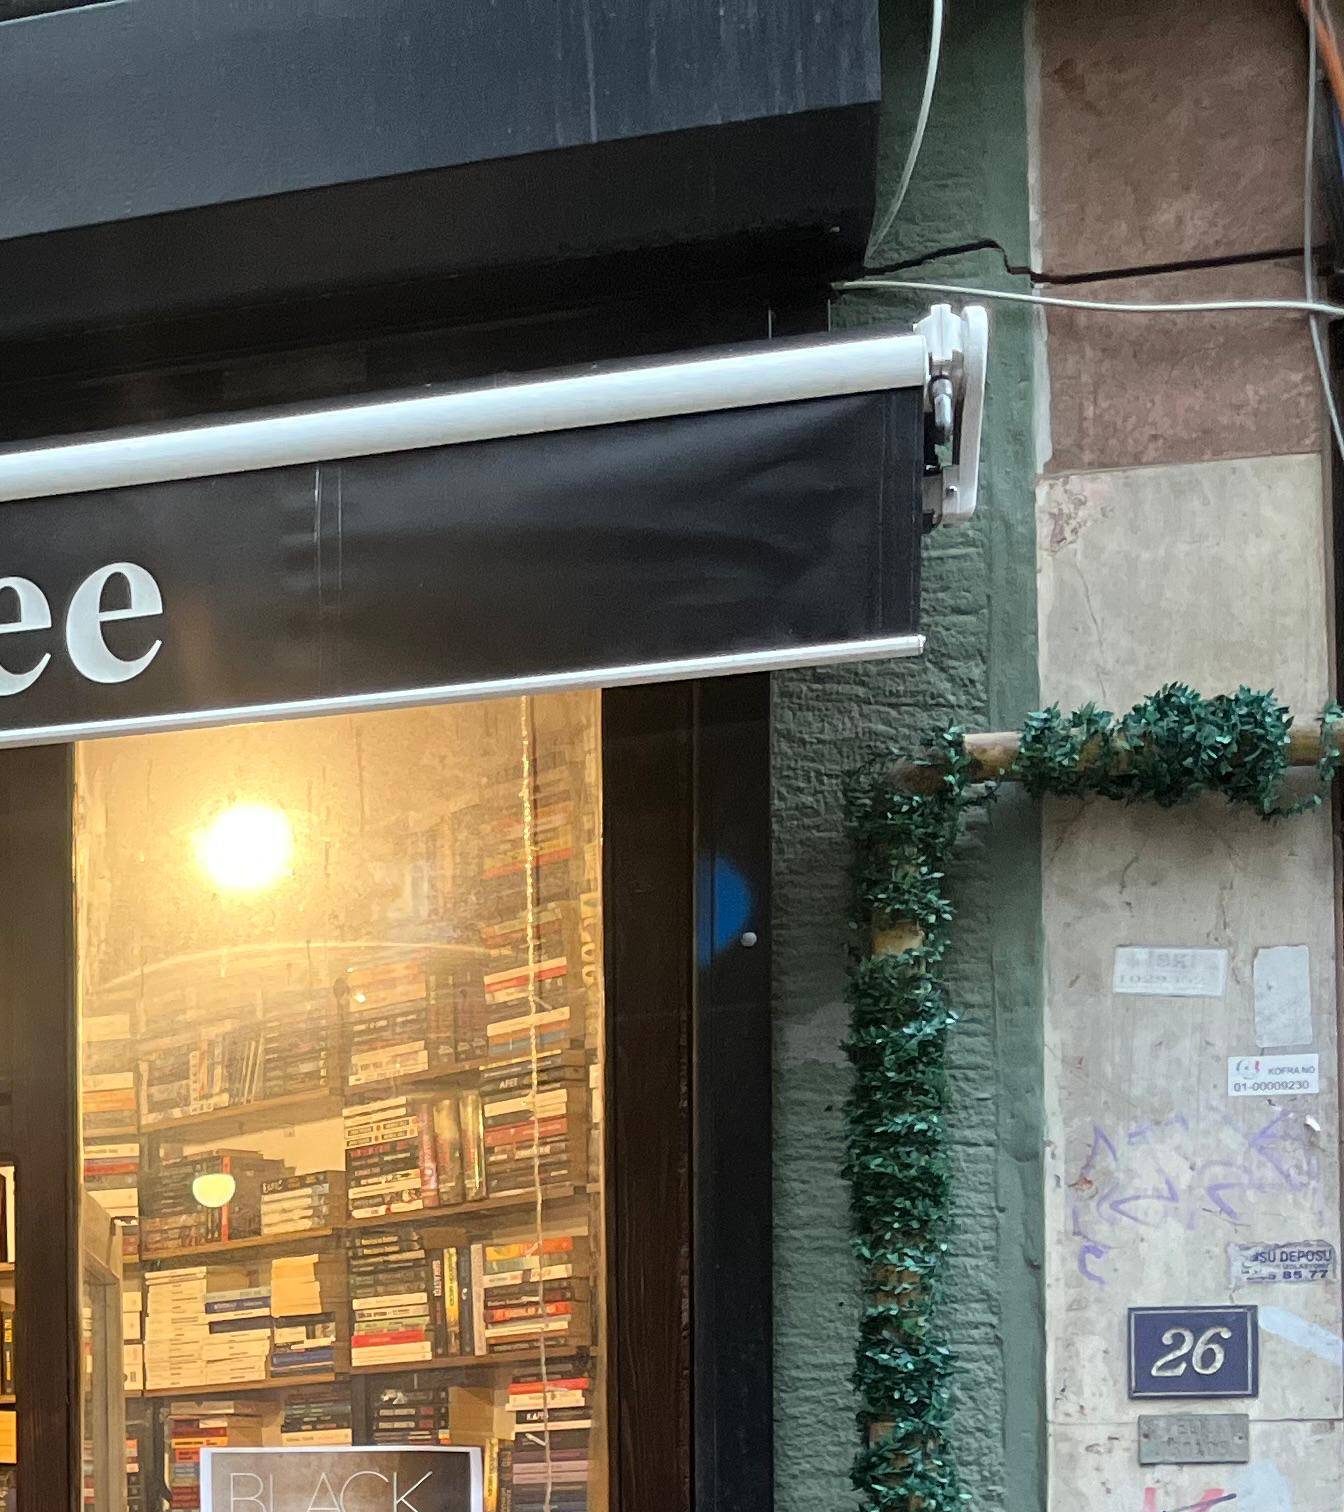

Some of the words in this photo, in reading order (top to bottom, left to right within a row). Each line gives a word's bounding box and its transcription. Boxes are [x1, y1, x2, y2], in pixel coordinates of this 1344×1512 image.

[1268, 1067, 1298, 1075] KOFRA
[1301, 1066, 1315, 1074] NO
[1280, 1249, 1332, 1262] DEPOSU
[1151, 1326, 1232, 1378] 26
